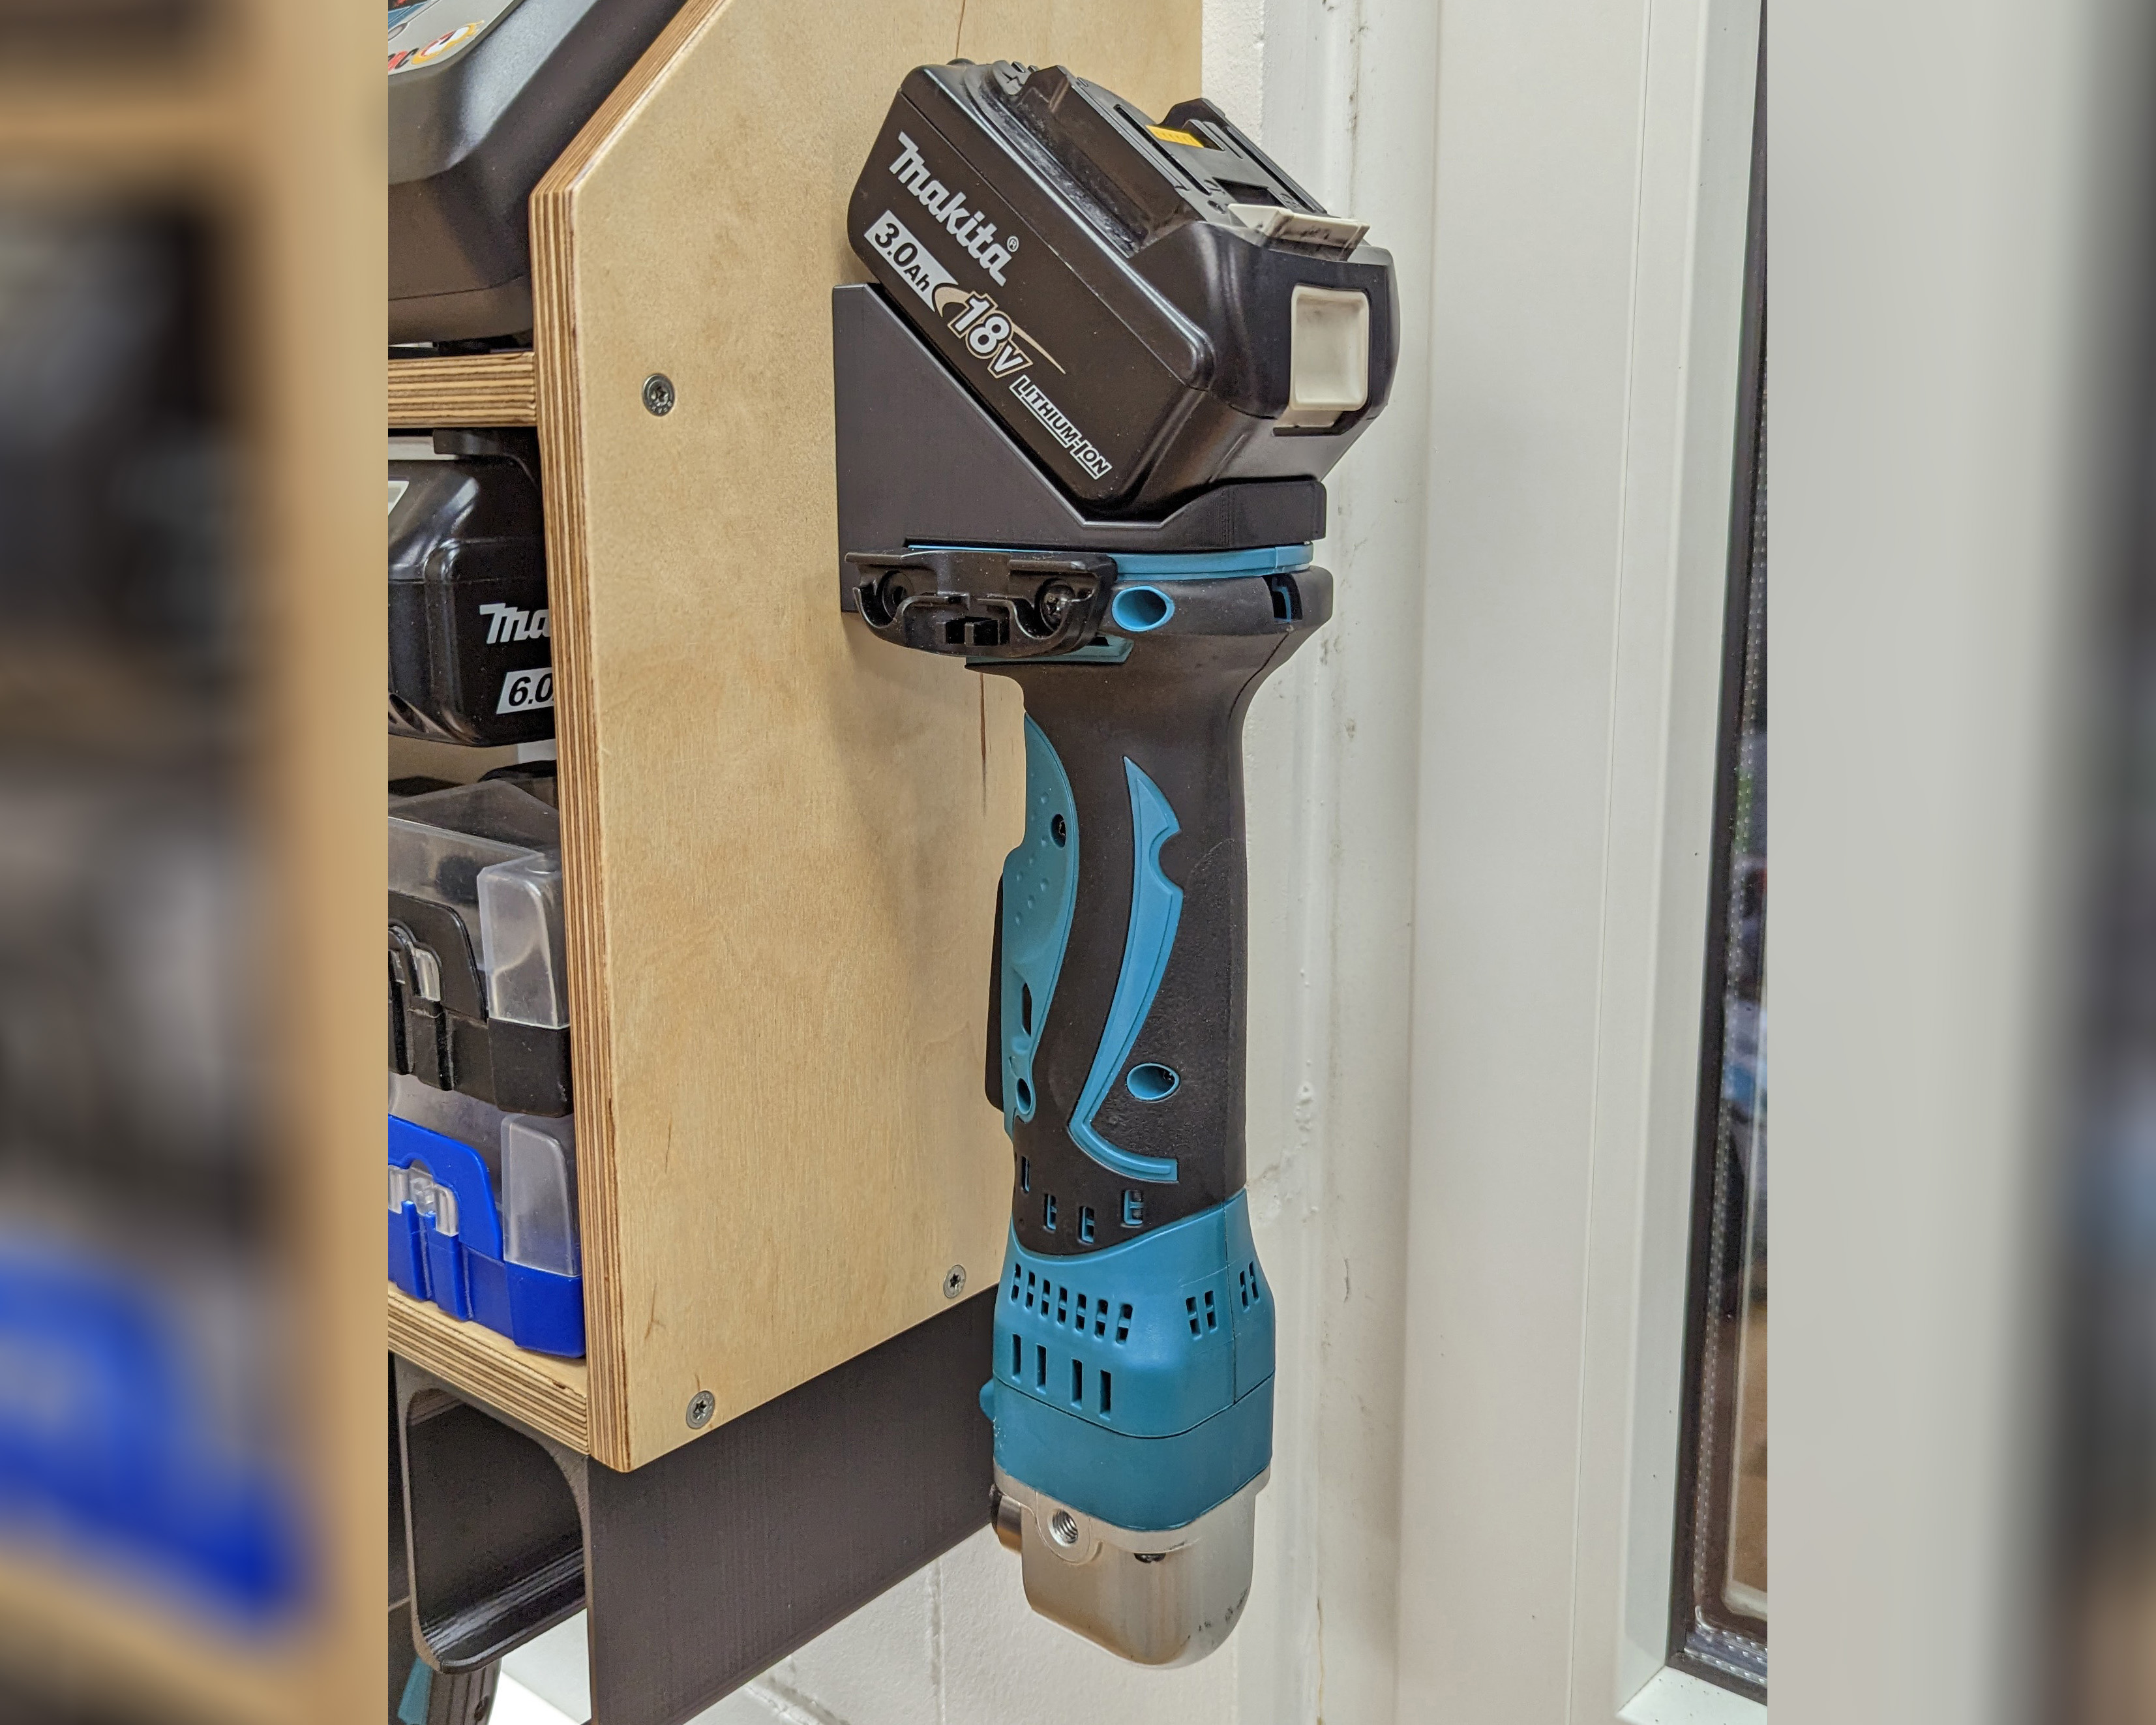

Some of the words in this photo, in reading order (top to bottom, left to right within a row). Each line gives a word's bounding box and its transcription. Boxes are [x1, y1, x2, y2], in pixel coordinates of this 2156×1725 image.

[875, 222, 931, 293] 3.0Ah
[1010, 374, 1113, 479] LITHIUM-ION
[509, 673, 554, 706] 6.0
